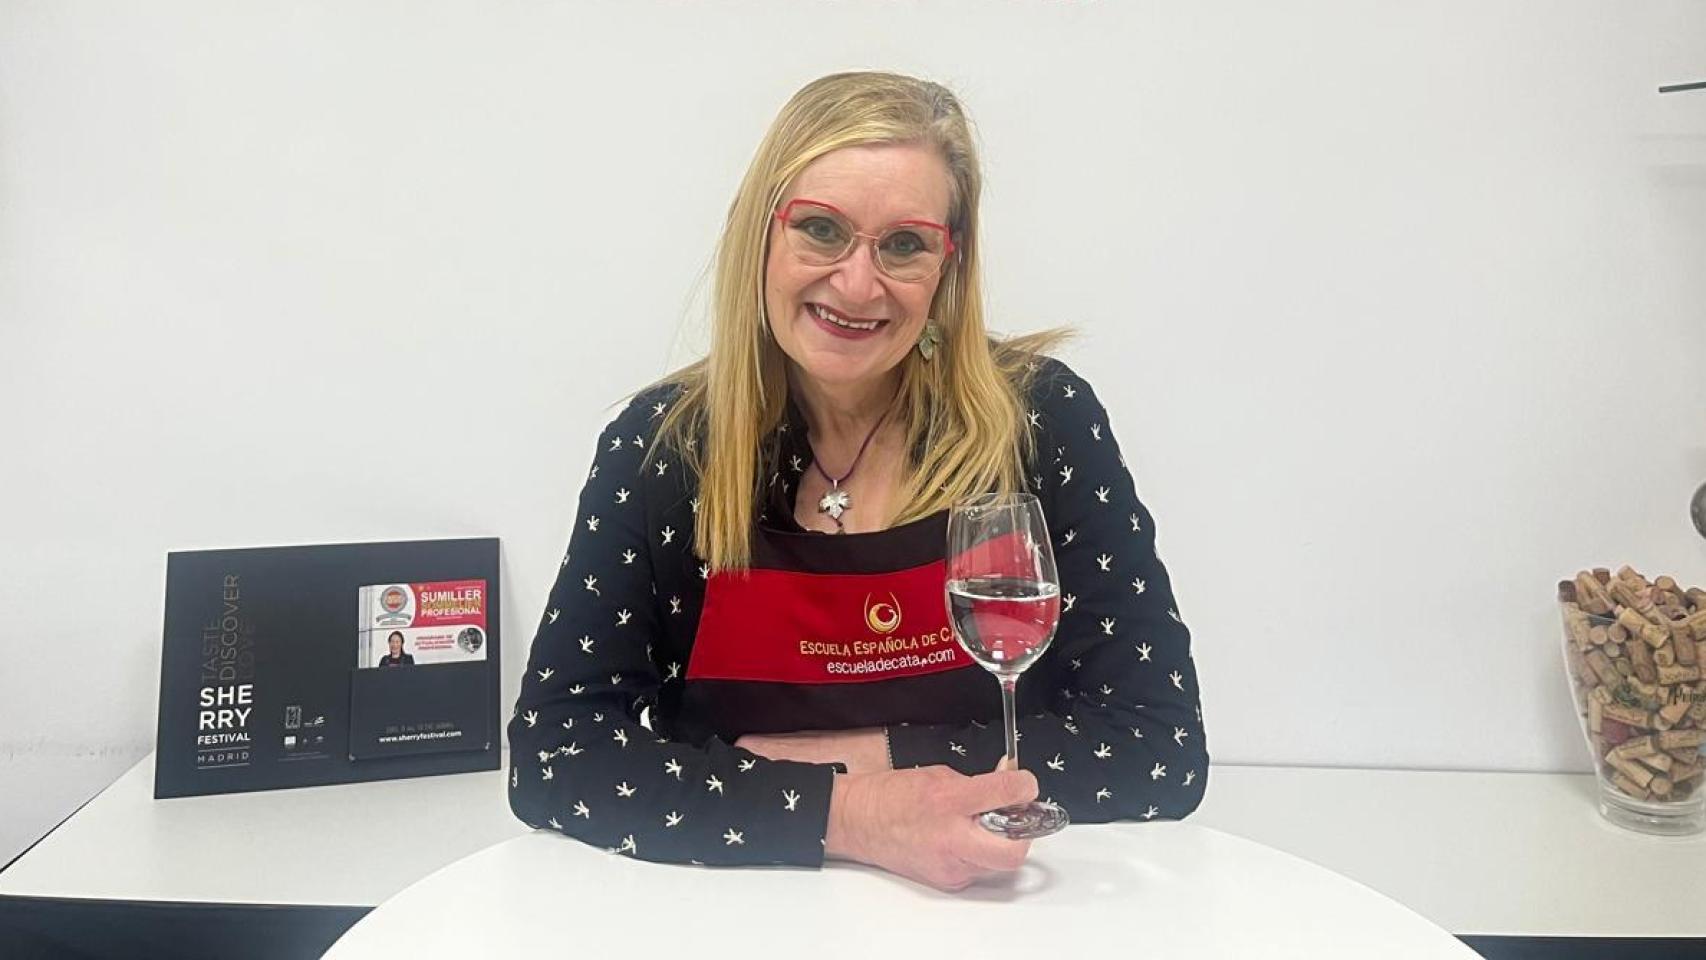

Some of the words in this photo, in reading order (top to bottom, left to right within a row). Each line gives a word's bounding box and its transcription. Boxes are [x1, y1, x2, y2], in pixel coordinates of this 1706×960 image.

[421, 589, 482, 603] SUMILLER
[422, 607, 482, 619] PROFESIONAL
[220, 575, 239, 681] DISCOVER
[201, 616, 220, 683] TASTE
[800, 640, 851, 657] ESCUELA
[853, 636, 919, 655] ESPAÑOLA
[921, 633, 938, 647] DE
[827, 647, 956, 675] escueladecata.com
[200, 684, 254, 707] SHE
[199, 707, 252, 731] RRY
[197, 732, 251, 745] FESTIVAL
[379, 730, 462, 743] www.sherryfestival.com
[197, 751, 250, 763] MADRID
